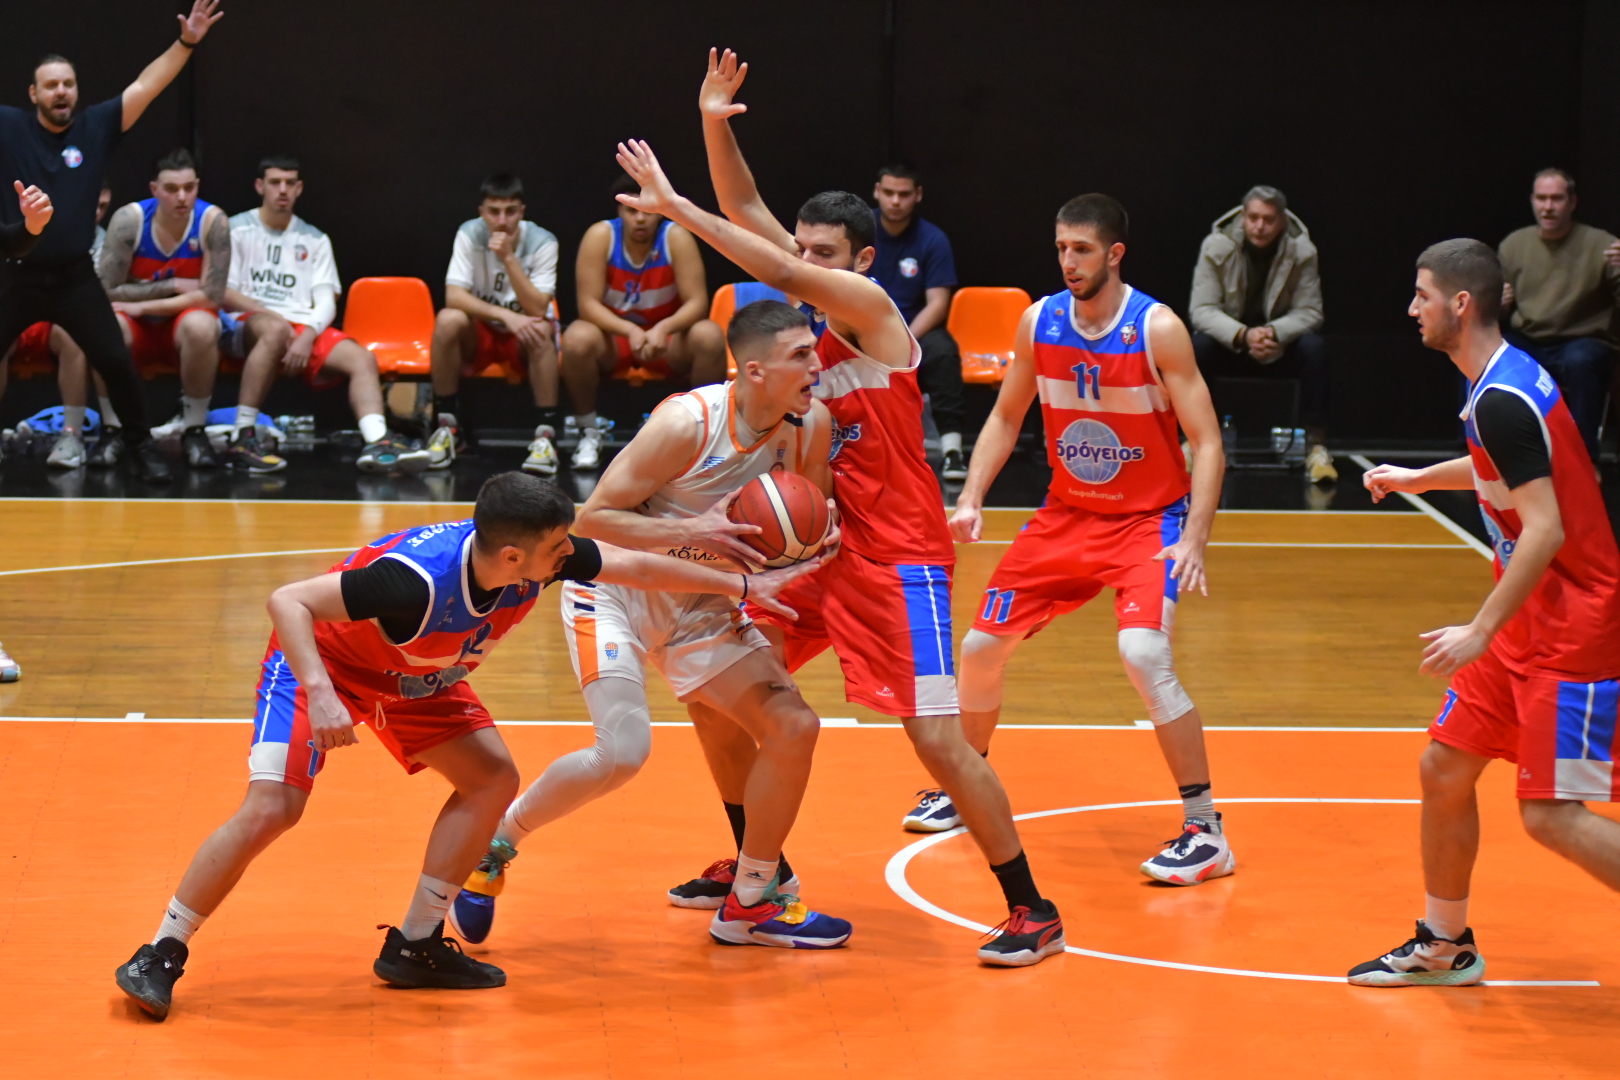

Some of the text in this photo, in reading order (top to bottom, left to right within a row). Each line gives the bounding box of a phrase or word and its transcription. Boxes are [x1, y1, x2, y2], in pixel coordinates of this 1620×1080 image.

[266, 244, 282, 265] 10
[250, 267, 297, 288] WIND
[494, 272, 505, 292] 6
[1071, 361, 1101, 401] 11
[982, 587, 1016, 624] 11
